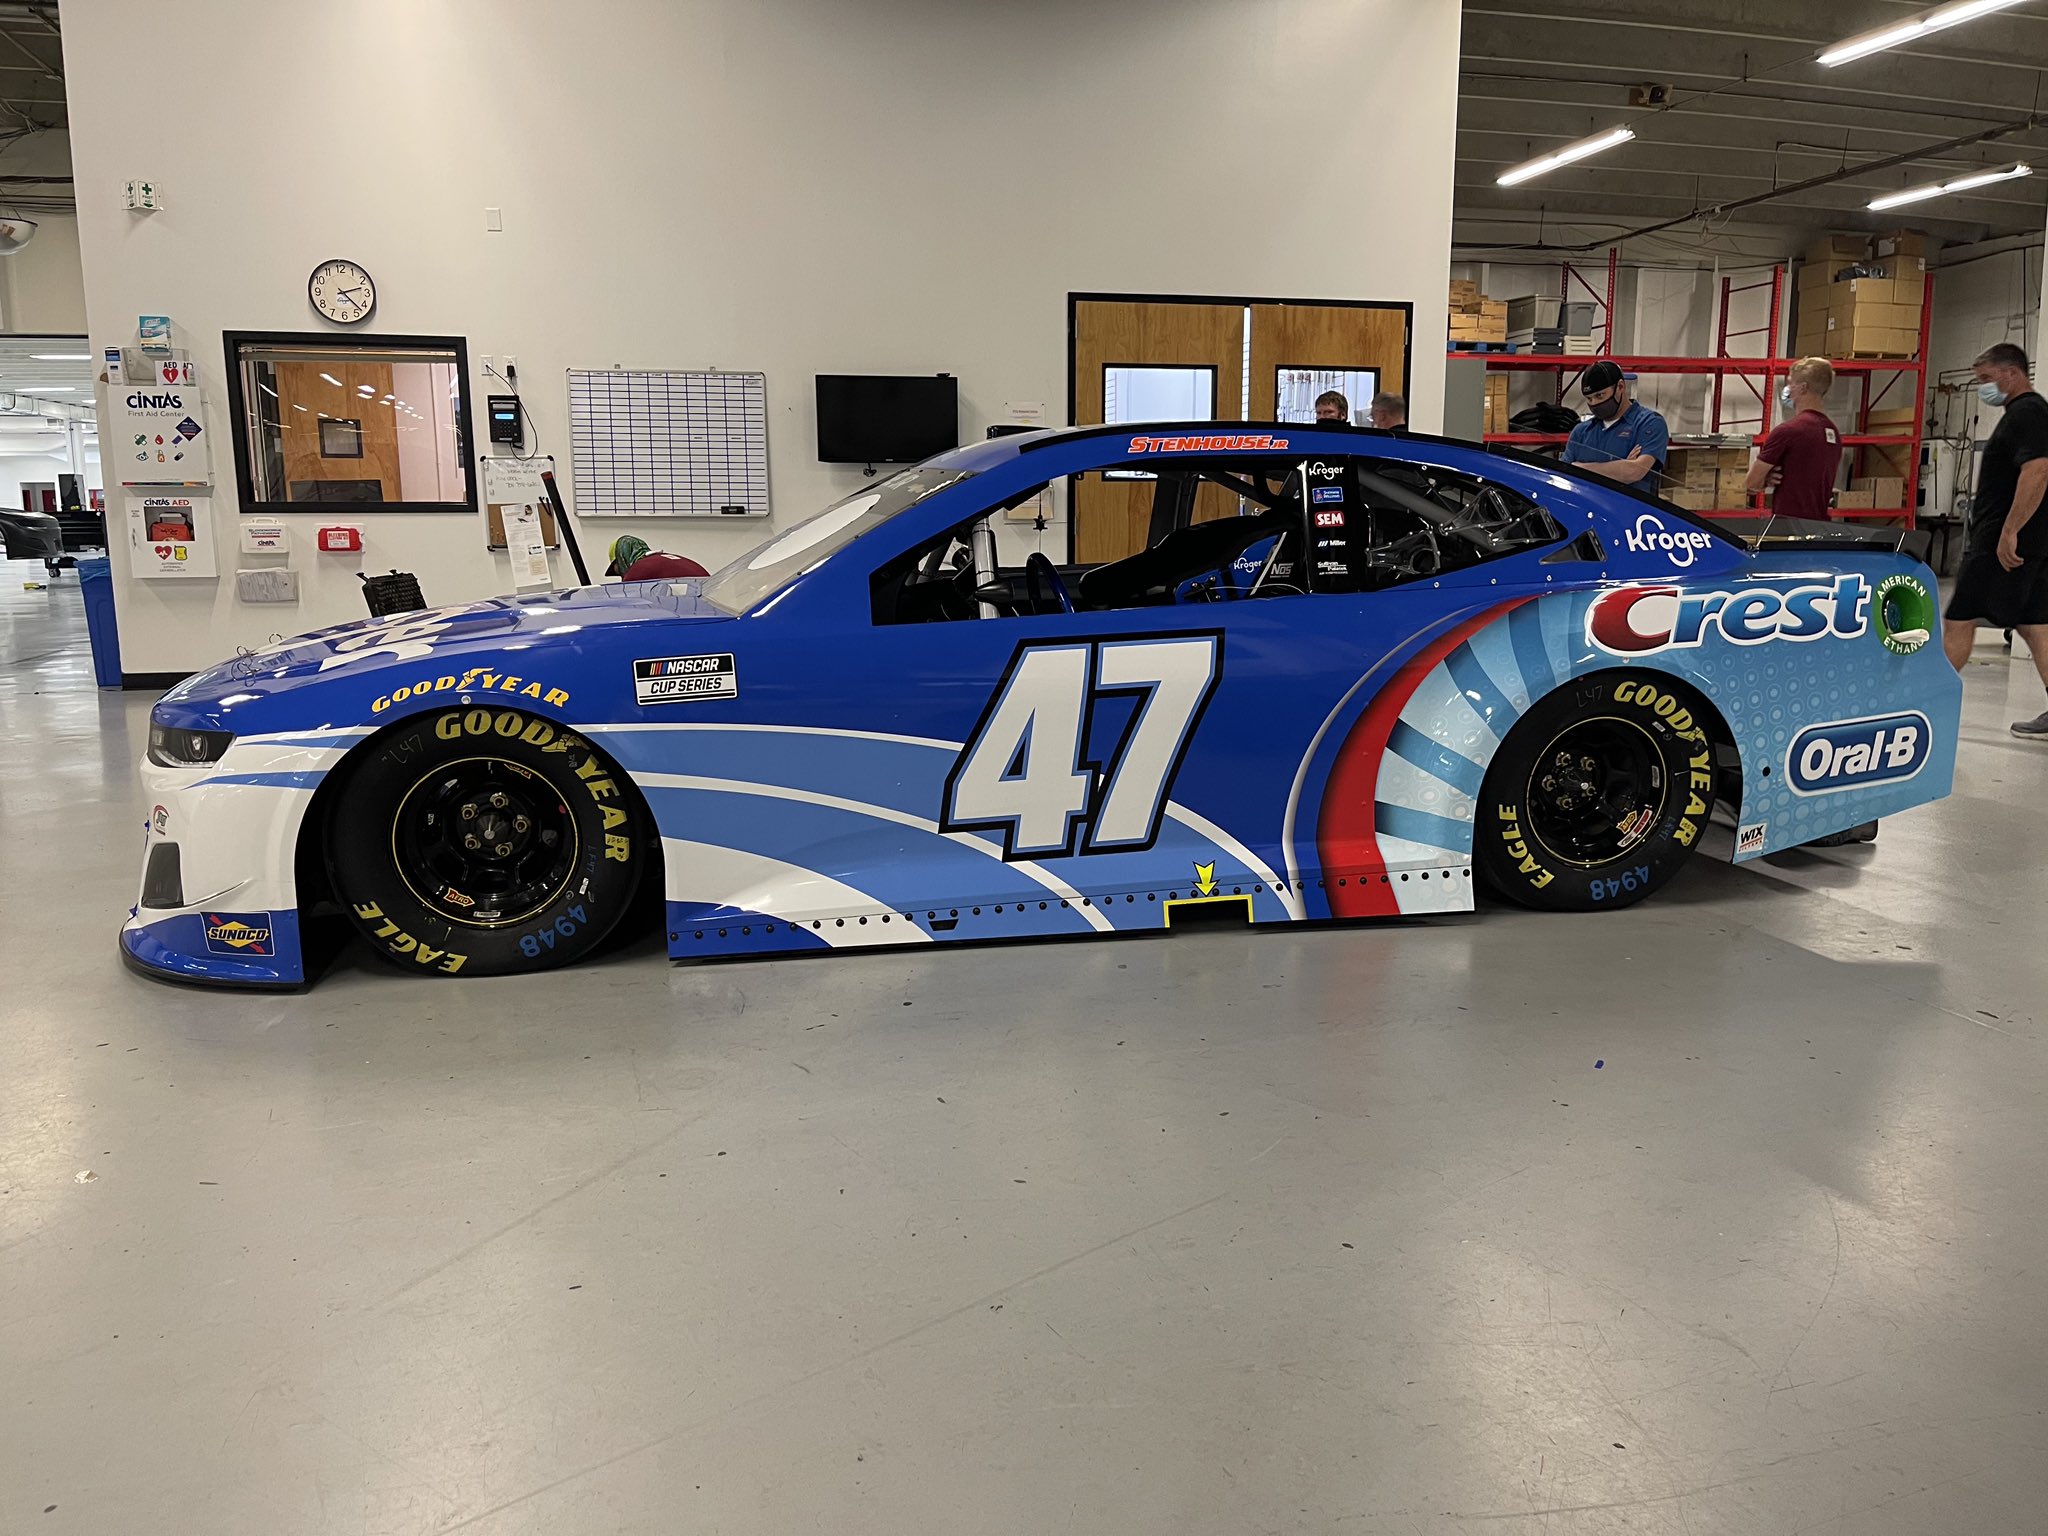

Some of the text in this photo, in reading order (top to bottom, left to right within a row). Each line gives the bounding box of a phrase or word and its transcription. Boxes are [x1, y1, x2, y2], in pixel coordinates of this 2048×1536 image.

[325, 268, 331, 276] 11
[336, 265, 346, 273] 12
[350, 268, 354, 276] 1
[315, 276, 325, 285] 10
[359, 276, 366, 285] 2
[314, 287, 321, 296] 9
[364, 289, 371, 297] 3
[319, 299, 326, 308] 8
[361, 300, 367, 309] 4
[329, 309, 336, 317] 7
[341, 311, 348, 320] 6
[353, 309, 360, 318] 5
[126, 391, 183, 408] CINTAS
[1128, 435, 1289, 453] STENHOUSE JR
[1309, 461, 1344, 480] Kroger
[1317, 513, 1344, 526] SEM
[1625, 514, 1712, 568] Kroger
[1233, 557, 1262, 573] Kroger
[1877, 575, 1926, 599] AMERICAN
[1585, 575, 1871, 656] Crest
[667, 658, 719, 674] NASCAR
[651, 677, 722, 694] CUP SERIES
[945, 634, 1219, 855] 47
[1800, 726, 1917, 781] Oral-B
[1741, 825, 1764, 844] WIX
[1499, 804, 1554, 888] EAGLE
[1589, 865, 1649, 900] 4948
[449, 893, 469, 904] AERO
[209, 928, 267, 940] SUNOCO
[353, 901, 467, 973] EAGLE
[519, 904, 587, 957] 4948
